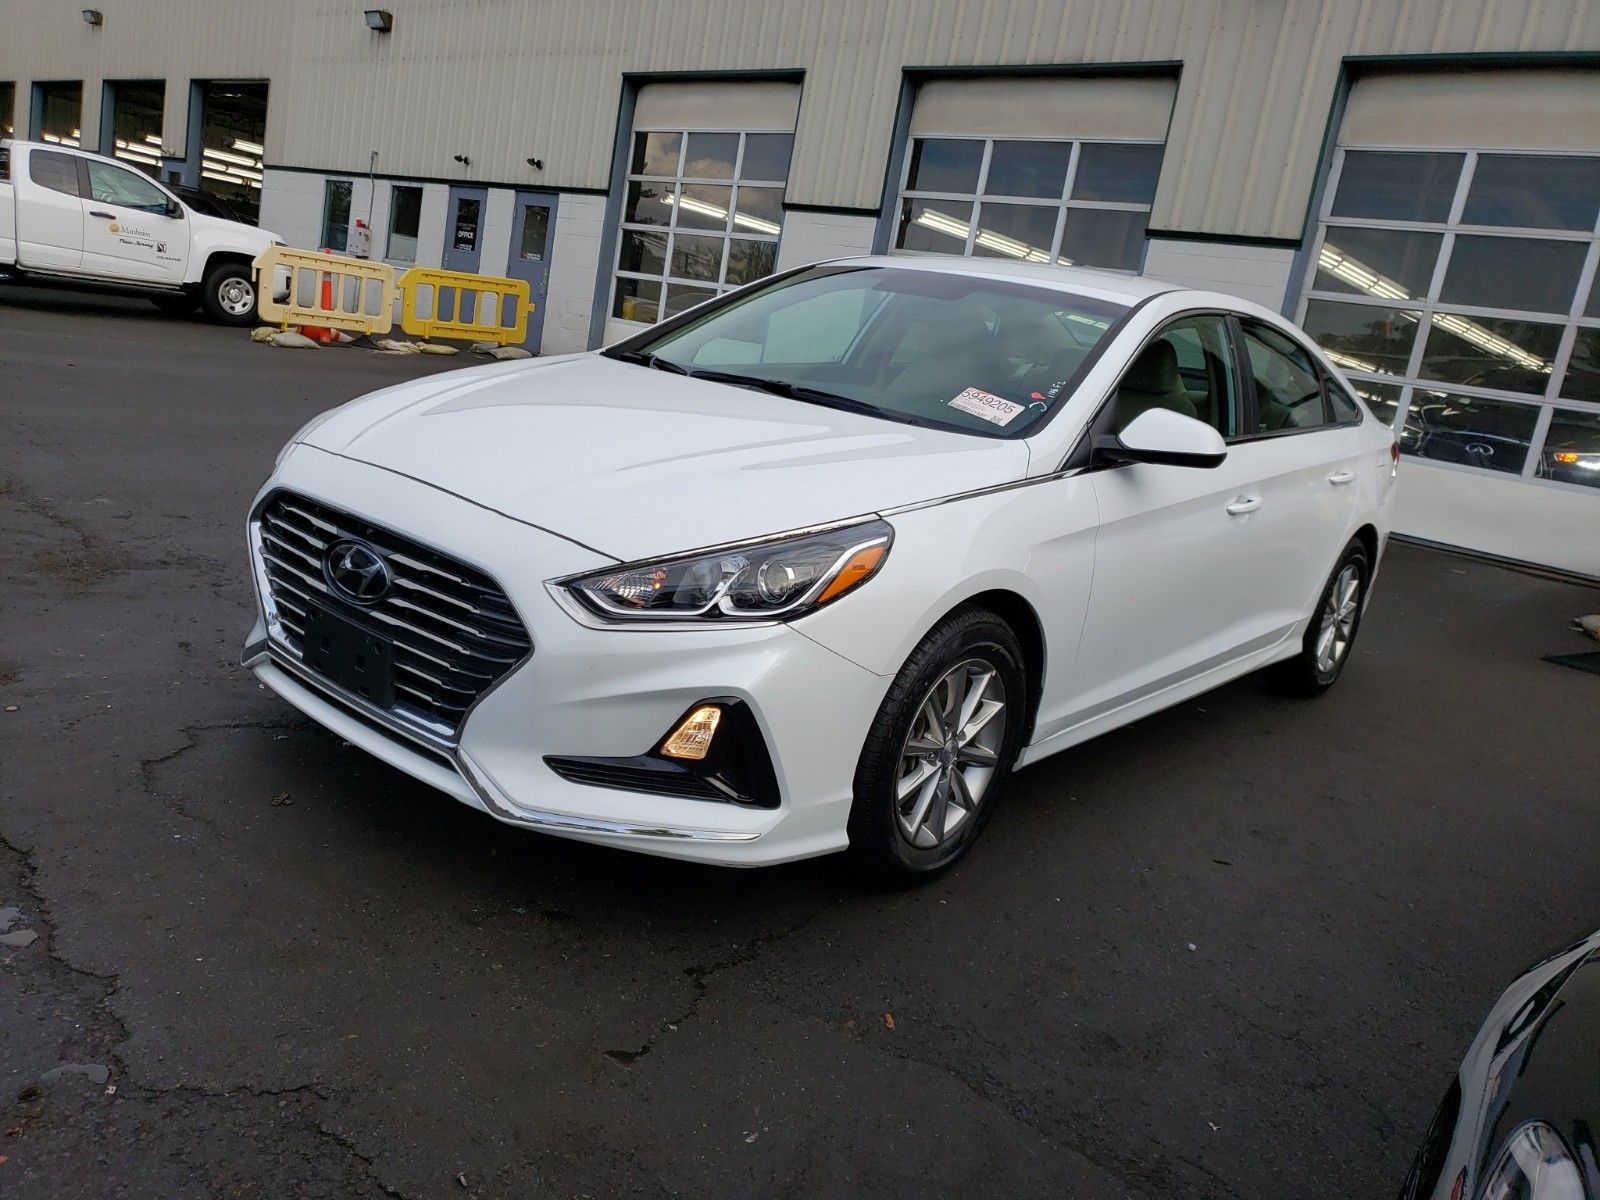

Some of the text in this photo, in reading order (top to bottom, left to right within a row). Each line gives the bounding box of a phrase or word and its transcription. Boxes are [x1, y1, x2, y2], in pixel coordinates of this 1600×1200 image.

[121, 226, 151, 237] Manheim
[457, 230, 475, 239] OFFICE
[134, 240, 154, 249] Jersey
[961, 389, 1016, 414] 5949205
